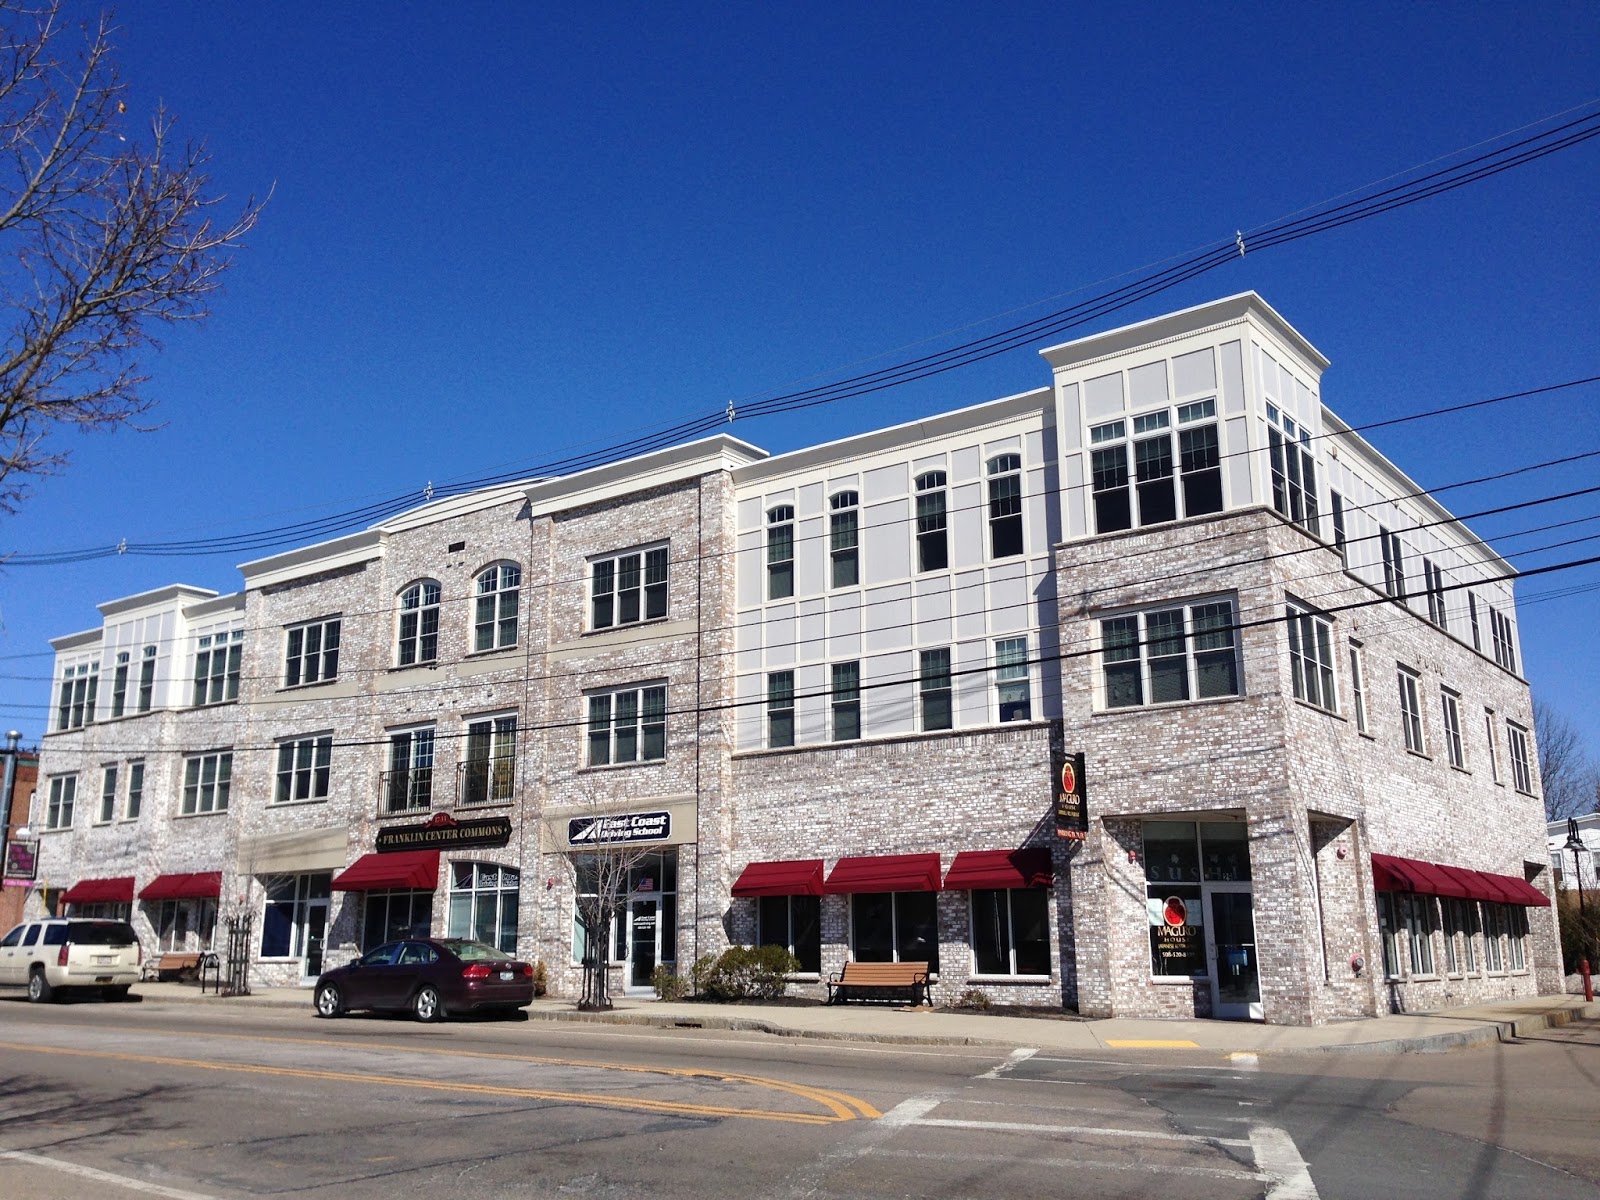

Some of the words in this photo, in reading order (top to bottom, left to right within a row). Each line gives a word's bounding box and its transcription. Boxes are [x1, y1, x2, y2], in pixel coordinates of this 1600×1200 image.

[603, 817, 629, 829] East
[631, 815, 667, 828] Coast
[383, 831, 424, 845] FRANKLIN
[425, 828, 458, 841] CENTER
[459, 825, 503, 839] COMMONS
[632, 827, 663, 836] School
[1157, 926, 1197, 936] MAGURO
